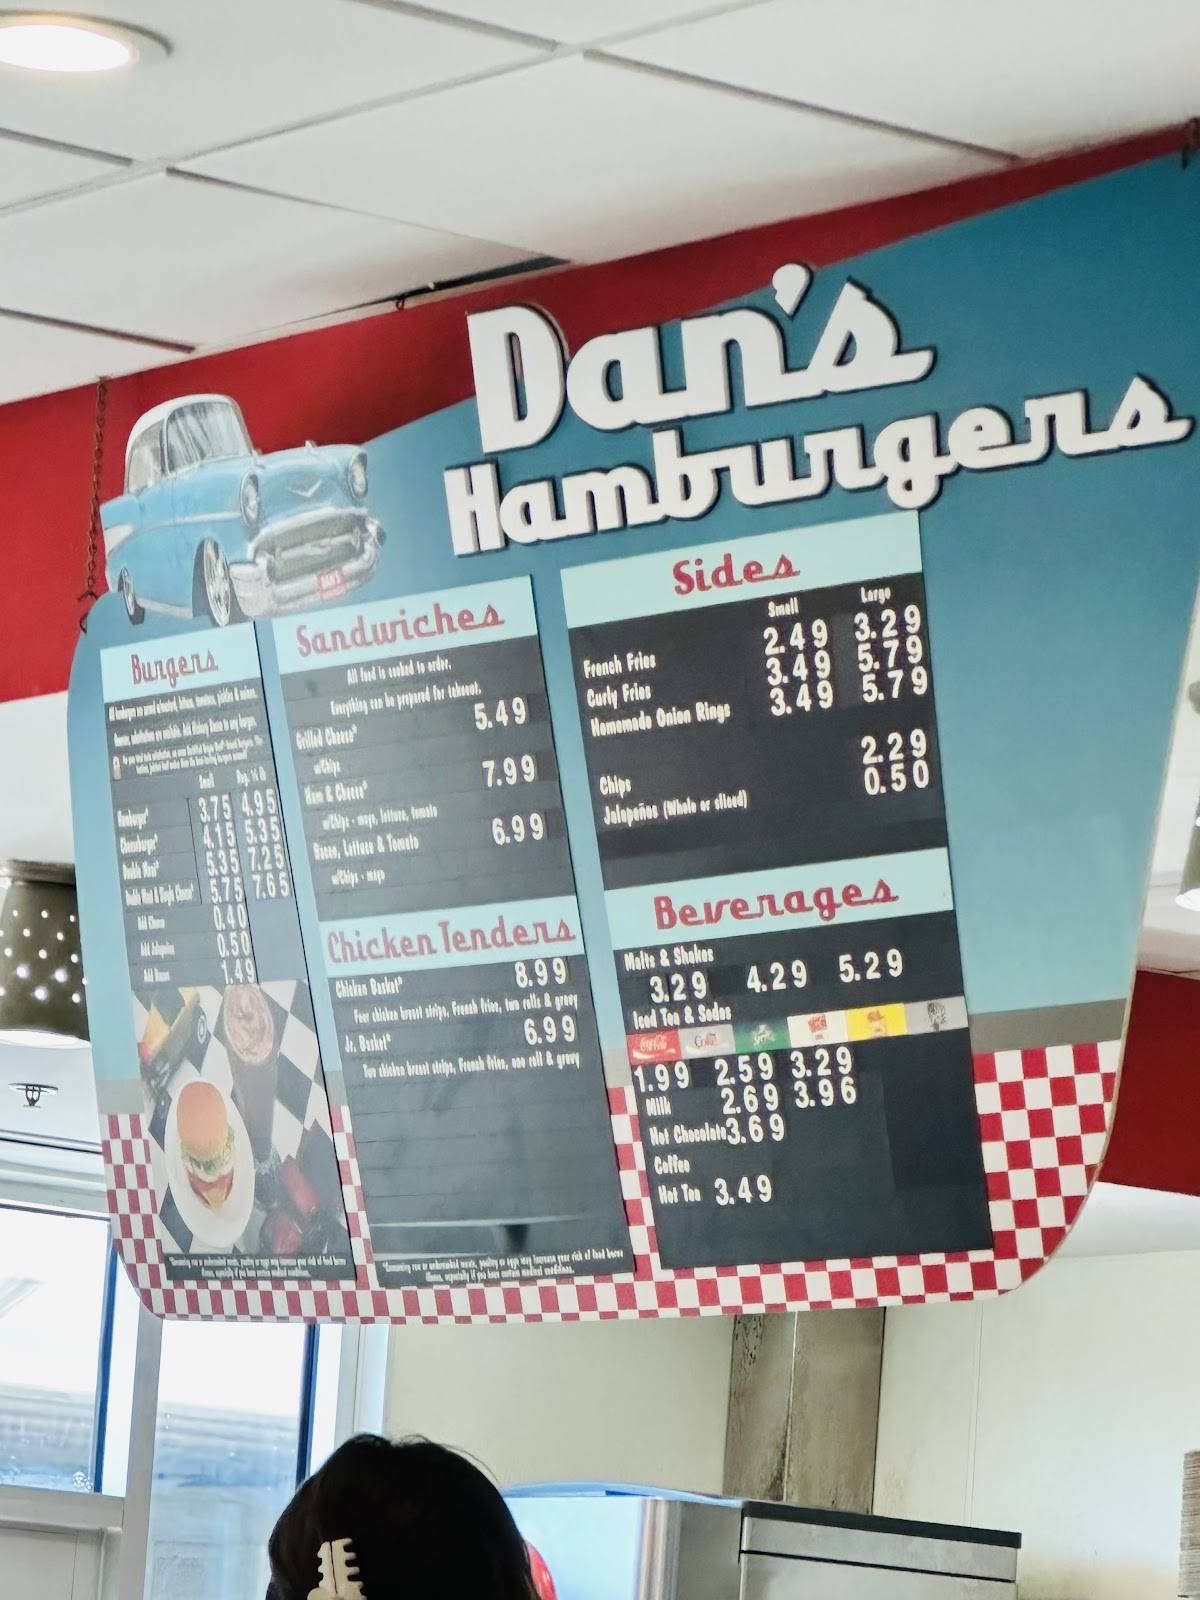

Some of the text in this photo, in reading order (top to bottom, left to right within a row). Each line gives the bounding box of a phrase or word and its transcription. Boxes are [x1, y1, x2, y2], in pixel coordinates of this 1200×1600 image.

[467, 262, 935, 454] Dan's
[444, 375, 1194, 556] Hamburgers
[672, 553, 800, 595] Sides
[768, 586, 891, 617] Small Large
[296, 602, 505, 657] Sandwiches
[763, 605, 921, 655] 2.49 3.29
[131, 650, 219, 688] Burgers
[347, 668, 358, 685] All
[360, 666, 376, 682] food
[379, 666, 386, 680] is
[388, 659, 414, 678] cooked
[417, 661, 425, 674] to
[583, 651, 656, 679] French Fries
[766, 635, 923, 686] 3.49 5.79
[330, 697, 368, 718] Everything
[370, 698, 383, 710] can
[384, 692, 394, 708] be
[397, 685, 430, 711] prepared
[433, 685, 444, 701] for
[587, 683, 651, 710] Curly Fries
[770, 666, 927, 716] 3.49 5.79
[474, 697, 526, 731] 5.49
[591, 702, 730, 737] Homemade Onion Rings
[296, 727, 323, 750] Grilled
[861, 728, 926, 764] 2.29
[482, 755, 535, 788] 7.99
[600, 775, 631, 799] Chips
[864, 760, 929, 795] 0.50
[199, 788, 276, 824] 3.75 4.95
[304, 785, 324, 805] Ham
[325, 784, 333, 802] &
[604, 789, 747, 827] Jalapeños (Whole or sliced)
[411, 803, 437, 819] tomato
[203, 816, 280, 848] 4.15 5.35
[342, 838, 374, 857] Lettuce
[377, 835, 385, 852] &
[386, 833, 419, 852] Tomato
[492, 813, 544, 846] 6.99
[206, 844, 284, 876] 5.35 7.25
[210, 872, 289, 903] 5.75 7.65
[213, 903, 247, 931] 0.40
[654, 879, 899, 930] Beverages
[217, 930, 250, 958] 0.50
[327, 915, 576, 964] Chicken Tenders
[221, 957, 255, 984] 1.49
[514, 957, 567, 988] 8.99
[624, 944, 714, 972] Malts & Shakes
[335, 979, 368, 998] Chicken
[649, 948, 903, 1003] 3.29 4.29 5.29
[372, 1006, 398, 1023] chicken
[400, 1005, 423, 1020] breast
[452, 998, 478, 1016] French
[505, 998, 520, 1011] two
[522, 992, 541, 1010] rolls
[544, 992, 552, 1008] &
[555, 994, 578, 1011] gravy
[632, 1002, 732, 1030] Iced Tea & Sodas
[345, 1034, 357, 1053] Jr.
[524, 1015, 575, 1045] 6.99
[362, 1063, 377, 1078] Two
[379, 1062, 405, 1078] chicken
[407, 1060, 430, 1076] breast
[458, 1055, 485, 1073] French
[511, 1057, 526, 1069] one
[528, 1050, 543, 1068] roll
[545, 1050, 554, 1066] &
[557, 1052, 580, 1070] gravy
[633, 1046, 853, 1093] 1.99 2.59 3.29
[646, 1096, 671, 1116] Milk
[721, 1076, 857, 1115] 2.69 3.96
[649, 1122, 726, 1146] Hot Chocolate
[726, 1113, 785, 1145] 3.69
[654, 1154, 690, 1174] Coffee
[658, 1183, 701, 1204] Hot Tea
[714, 1175, 772, 1206] 3.49
